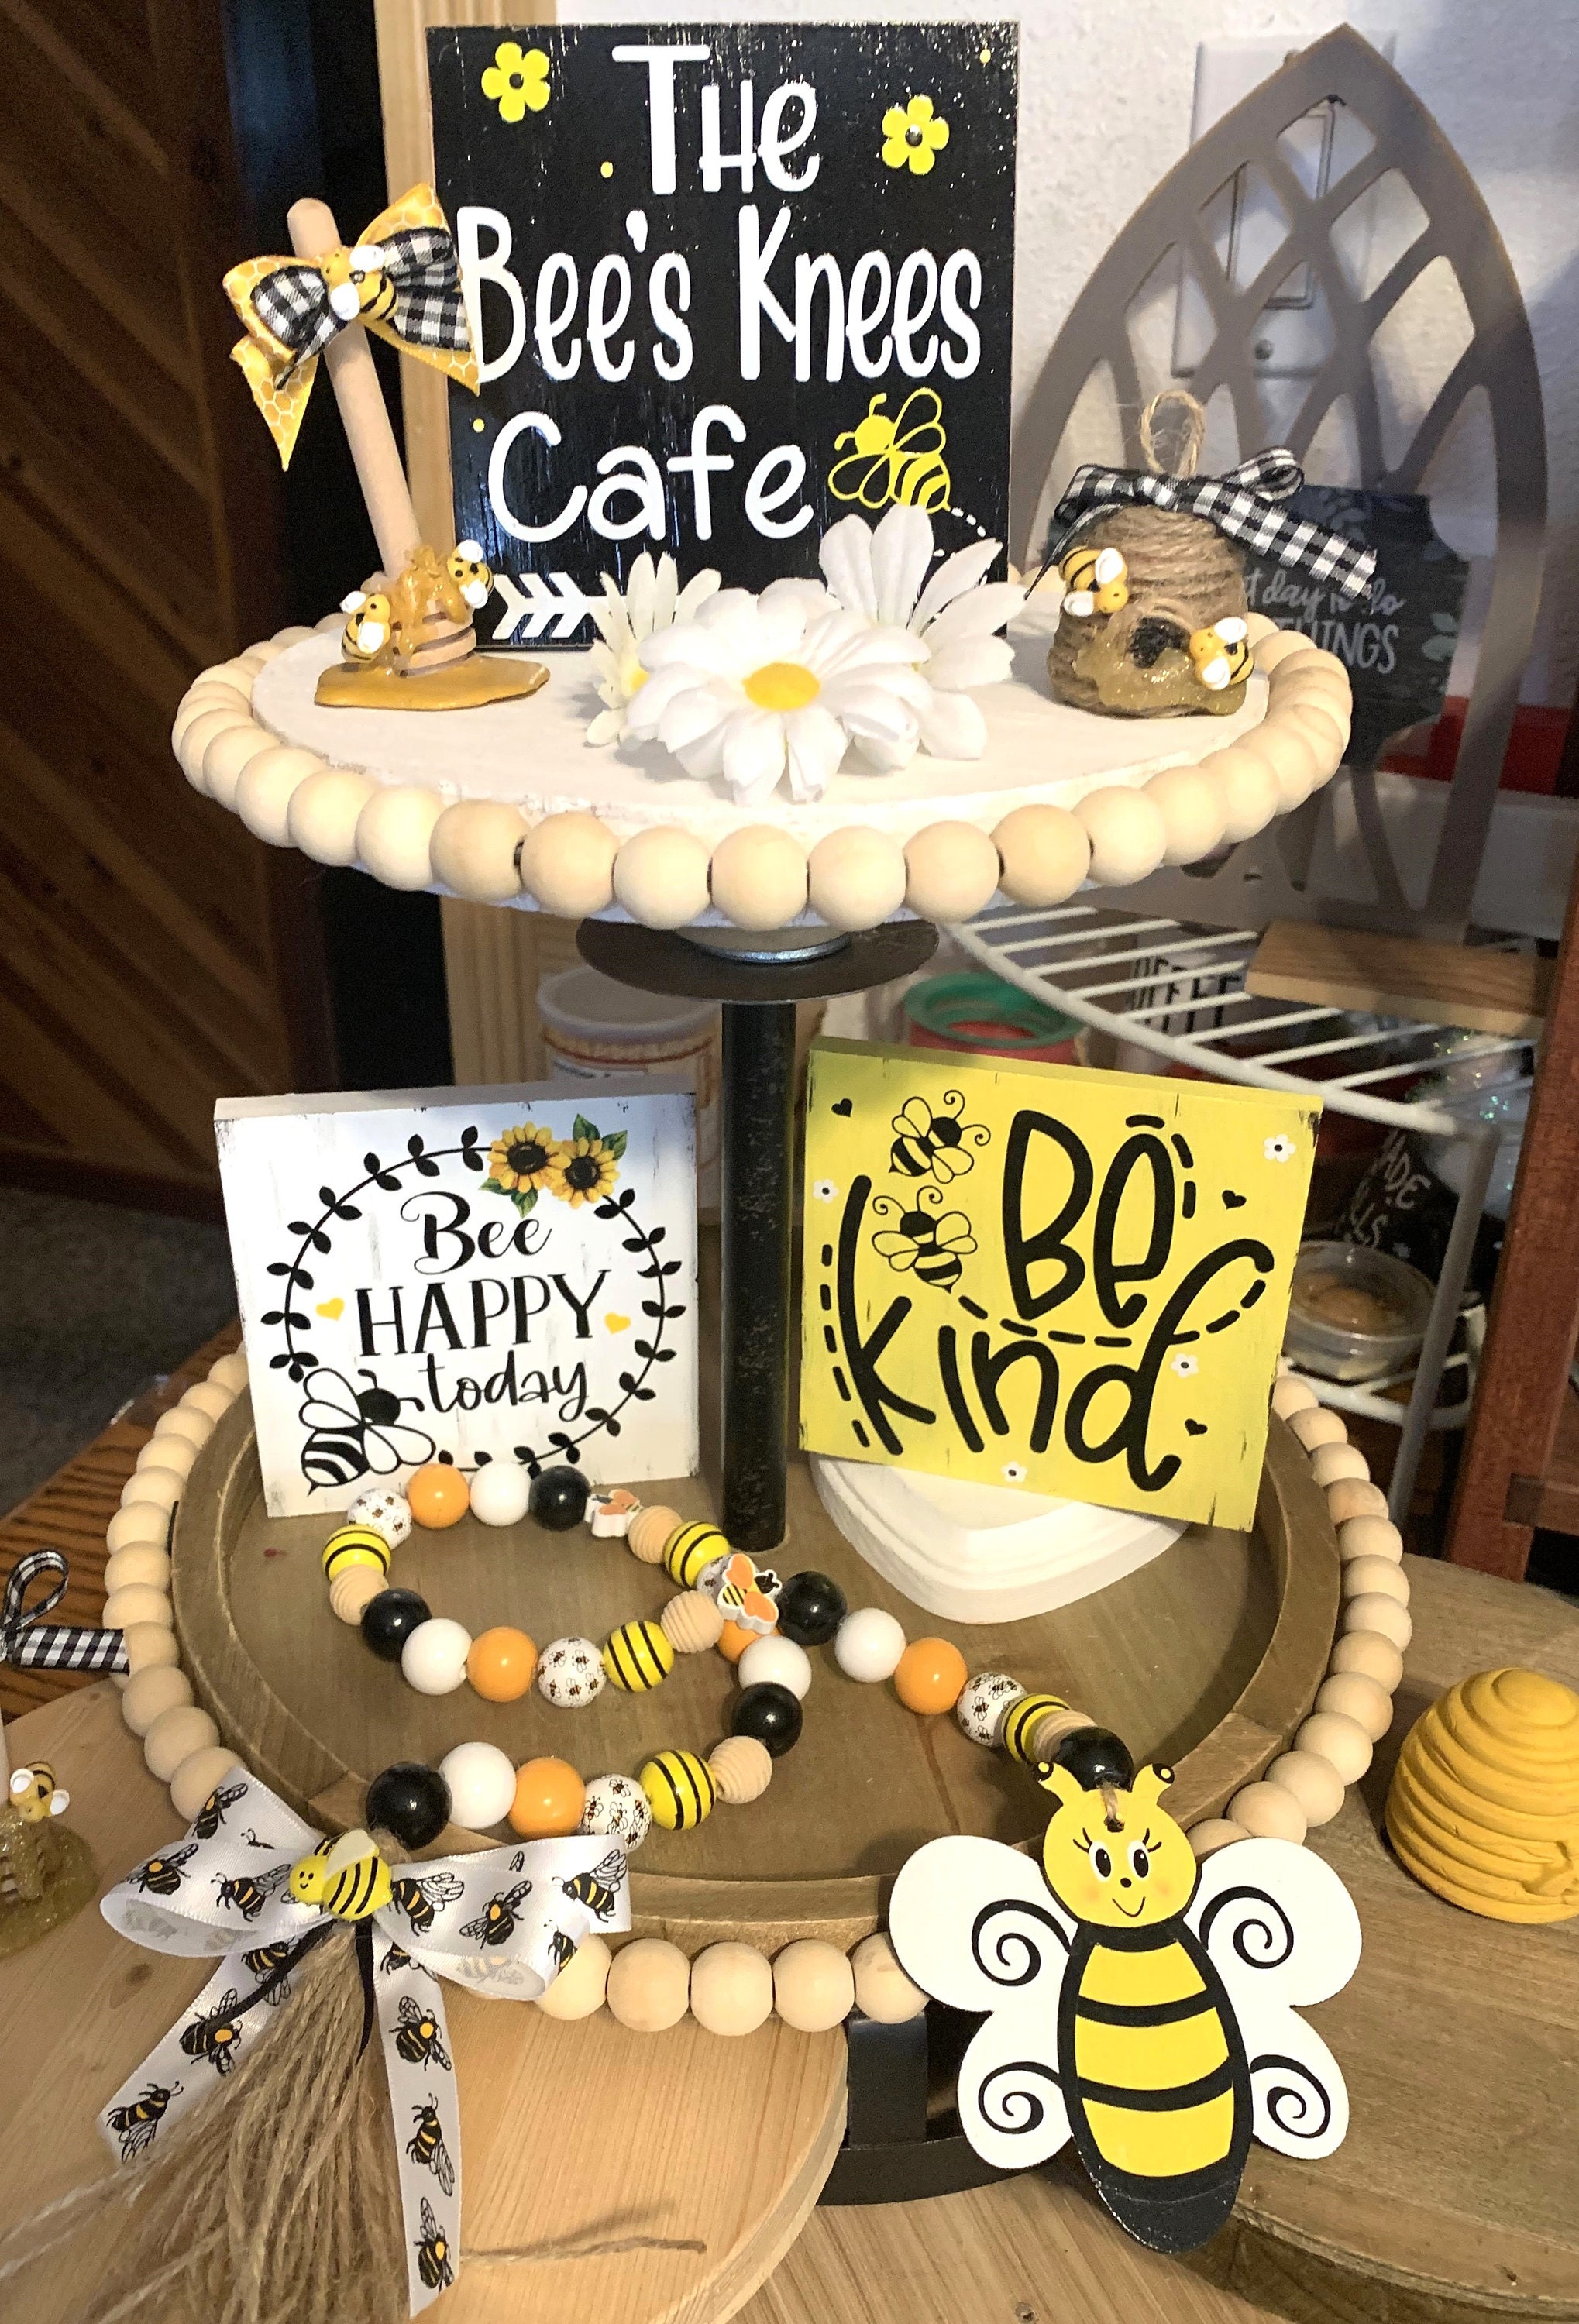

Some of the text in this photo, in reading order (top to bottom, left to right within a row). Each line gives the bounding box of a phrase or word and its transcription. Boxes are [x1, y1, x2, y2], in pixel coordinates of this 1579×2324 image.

[457, 205, 982, 384] Bee's Knees
[488, 404, 814, 544] Cafe
[1263, 569, 1326, 624] day
[400, 1191, 552, 1274] Bee
[1002, 1109, 1175, 1329] Be
[355, 1269, 611, 1357] HAPPY
[418, 1349, 588, 1422] today
